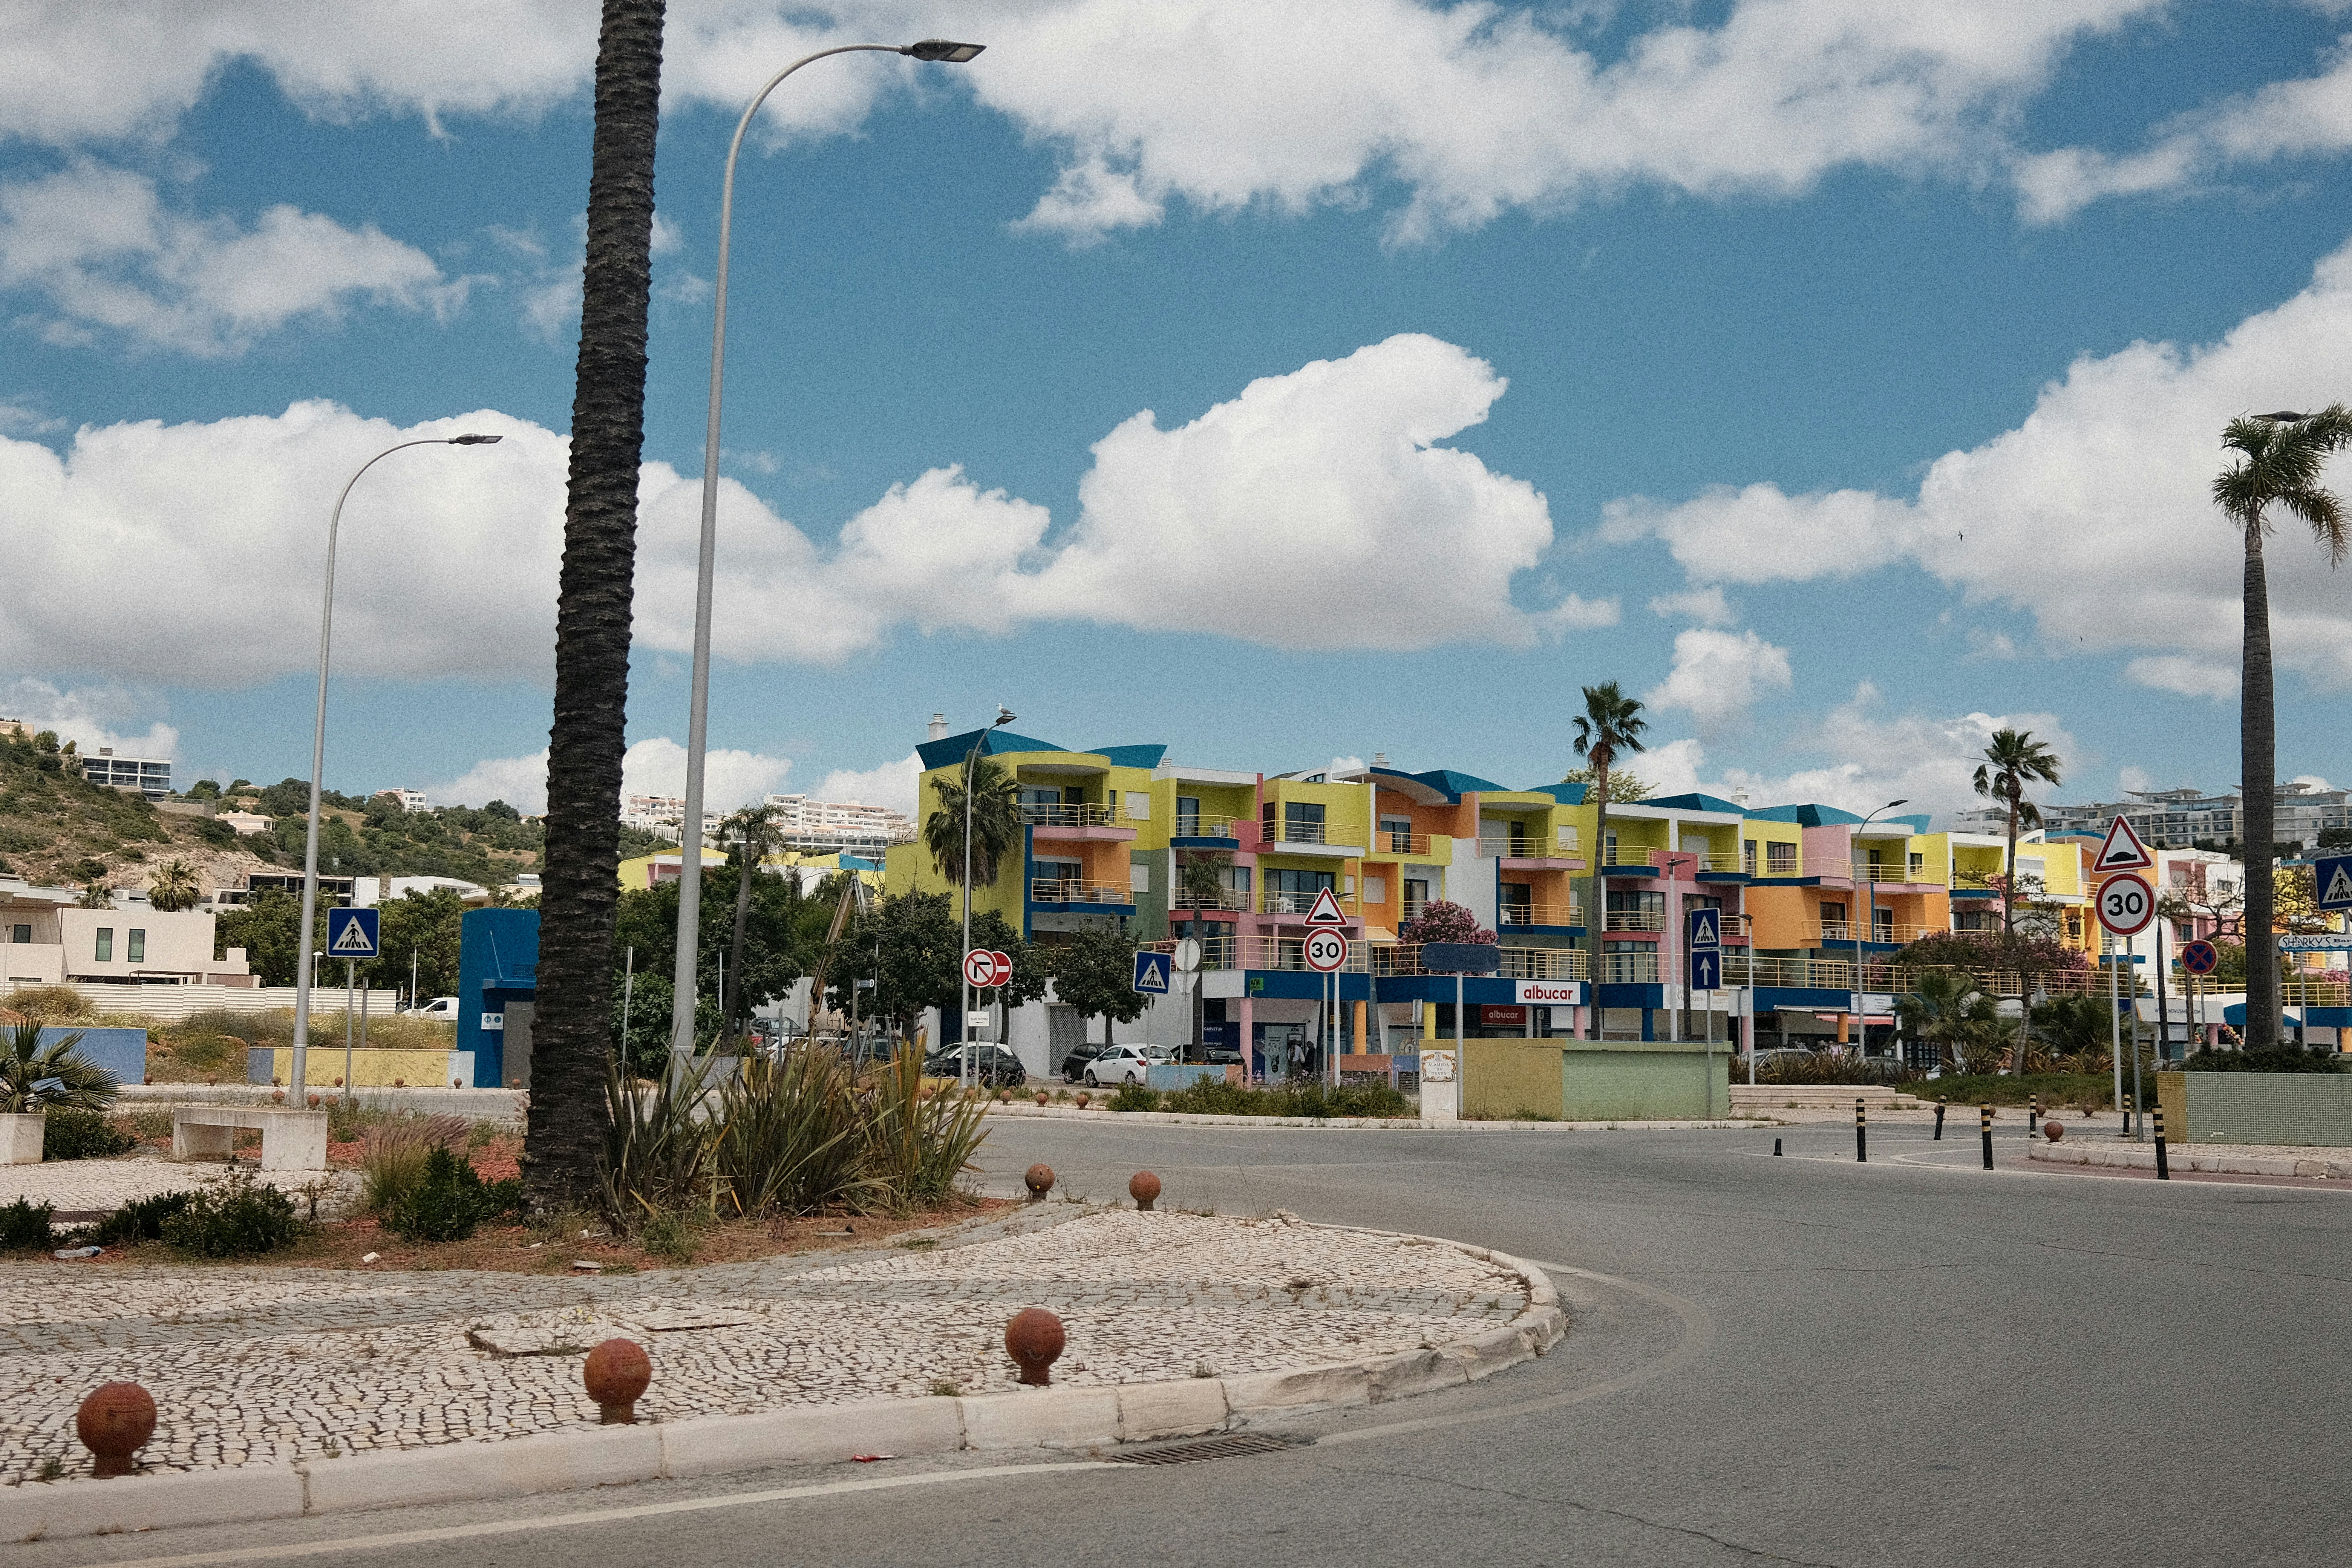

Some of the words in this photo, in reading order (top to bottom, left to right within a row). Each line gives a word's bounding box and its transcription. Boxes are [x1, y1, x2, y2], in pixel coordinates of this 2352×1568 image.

[2107, 892, 2143, 916] 30
[2283, 936, 2331, 946] SHARKY'S
[1311, 942, 1339, 958] 30
[1524, 985, 1573, 1000] albucar
[1489, 1010, 1519, 1018] albucar
